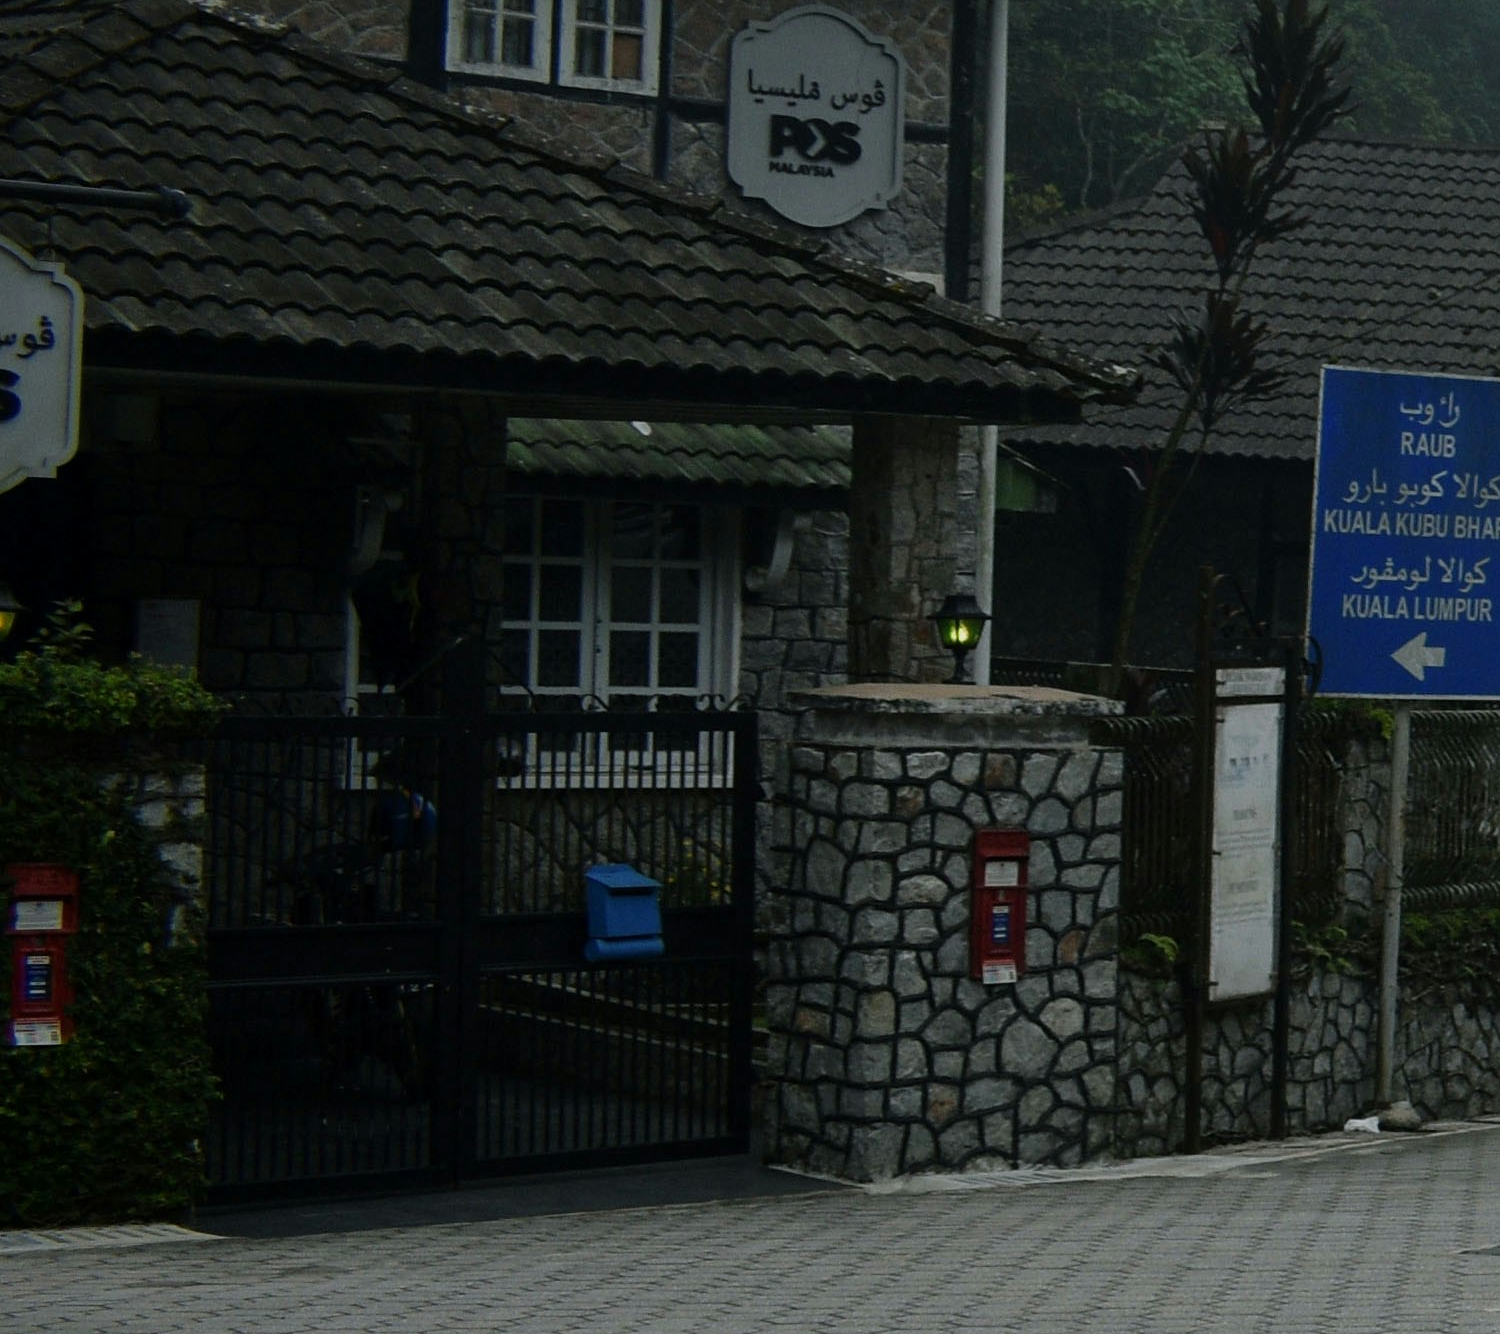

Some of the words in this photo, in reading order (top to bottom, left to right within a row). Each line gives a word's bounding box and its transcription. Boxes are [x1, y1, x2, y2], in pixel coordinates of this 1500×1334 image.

[770, 114, 862, 166] POS
[768, 161, 834, 178] MALAYSIA
[1400, 432, 1456, 458] RAUB
[1324, 508, 1391, 536] KUALA
[1395, 512, 1448, 538] KUBU
[1342, 594, 1409, 619] KUALA
[1414, 596, 1492, 622] LUMPUR
